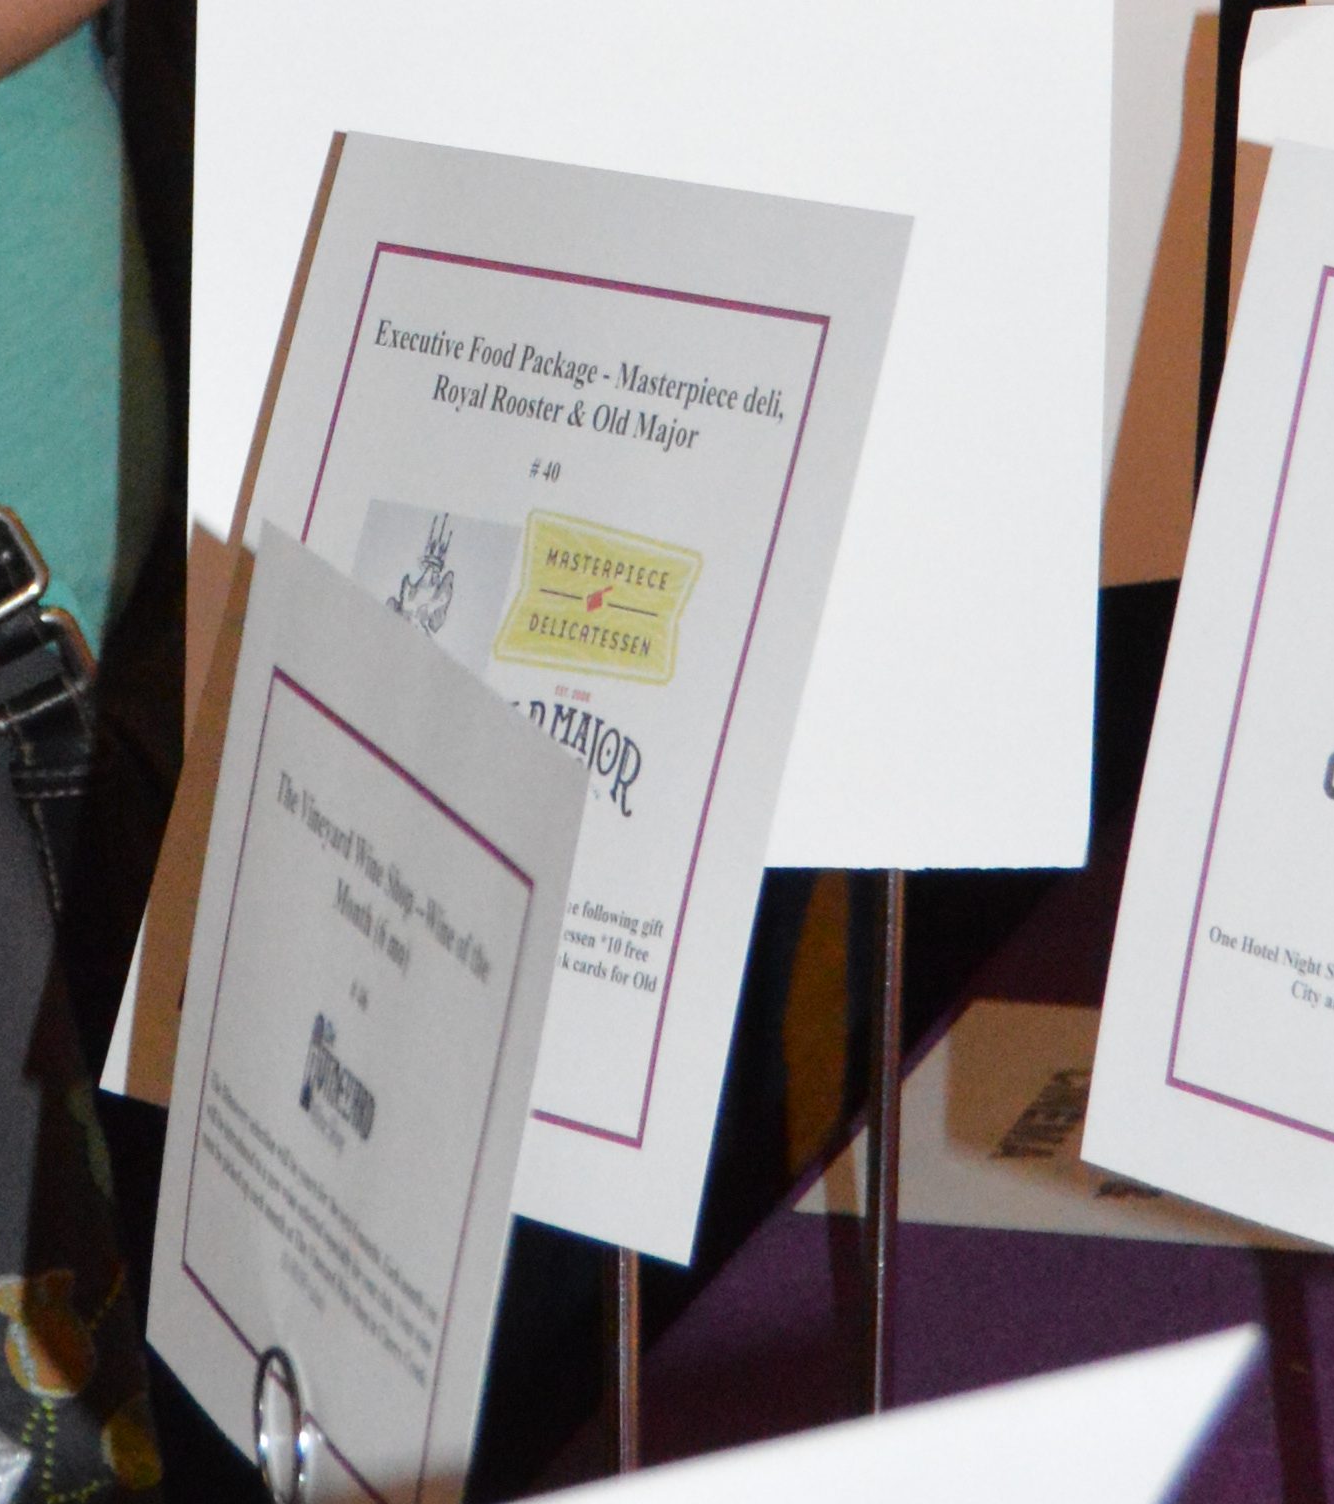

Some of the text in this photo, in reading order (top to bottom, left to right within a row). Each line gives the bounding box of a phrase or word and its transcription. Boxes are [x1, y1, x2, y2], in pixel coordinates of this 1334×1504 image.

[375, 319, 464, 360] Executive
[468, 336, 517, 369] Food
[518, 345, 598, 389] Package
[615, 362, 738, 410] Masterpiece
[742, 386, 784, 423] deli,
[432, 374, 700, 452] Royal Rooster & Old Major
[542, 461, 562, 483] 40
[545, 547, 670, 591] MASTERPIECE
[528, 613, 651, 657] DELICATESSEN
[550, 703, 642, 817] MAJOR
[278, 771, 299, 814] The
[581, 900, 639, 936] following
[640, 918, 664, 940] gift
[623, 940, 650, 963] free
[1208, 925, 1238, 950] One
[1240, 935, 1280, 964] Hotel
[1282, 949, 1322, 977] Night
[572, 959, 607, 980] cards
[610, 964, 632, 986] for
[632, 971, 658, 993] Old
[1291, 980, 1322, 1009] City
